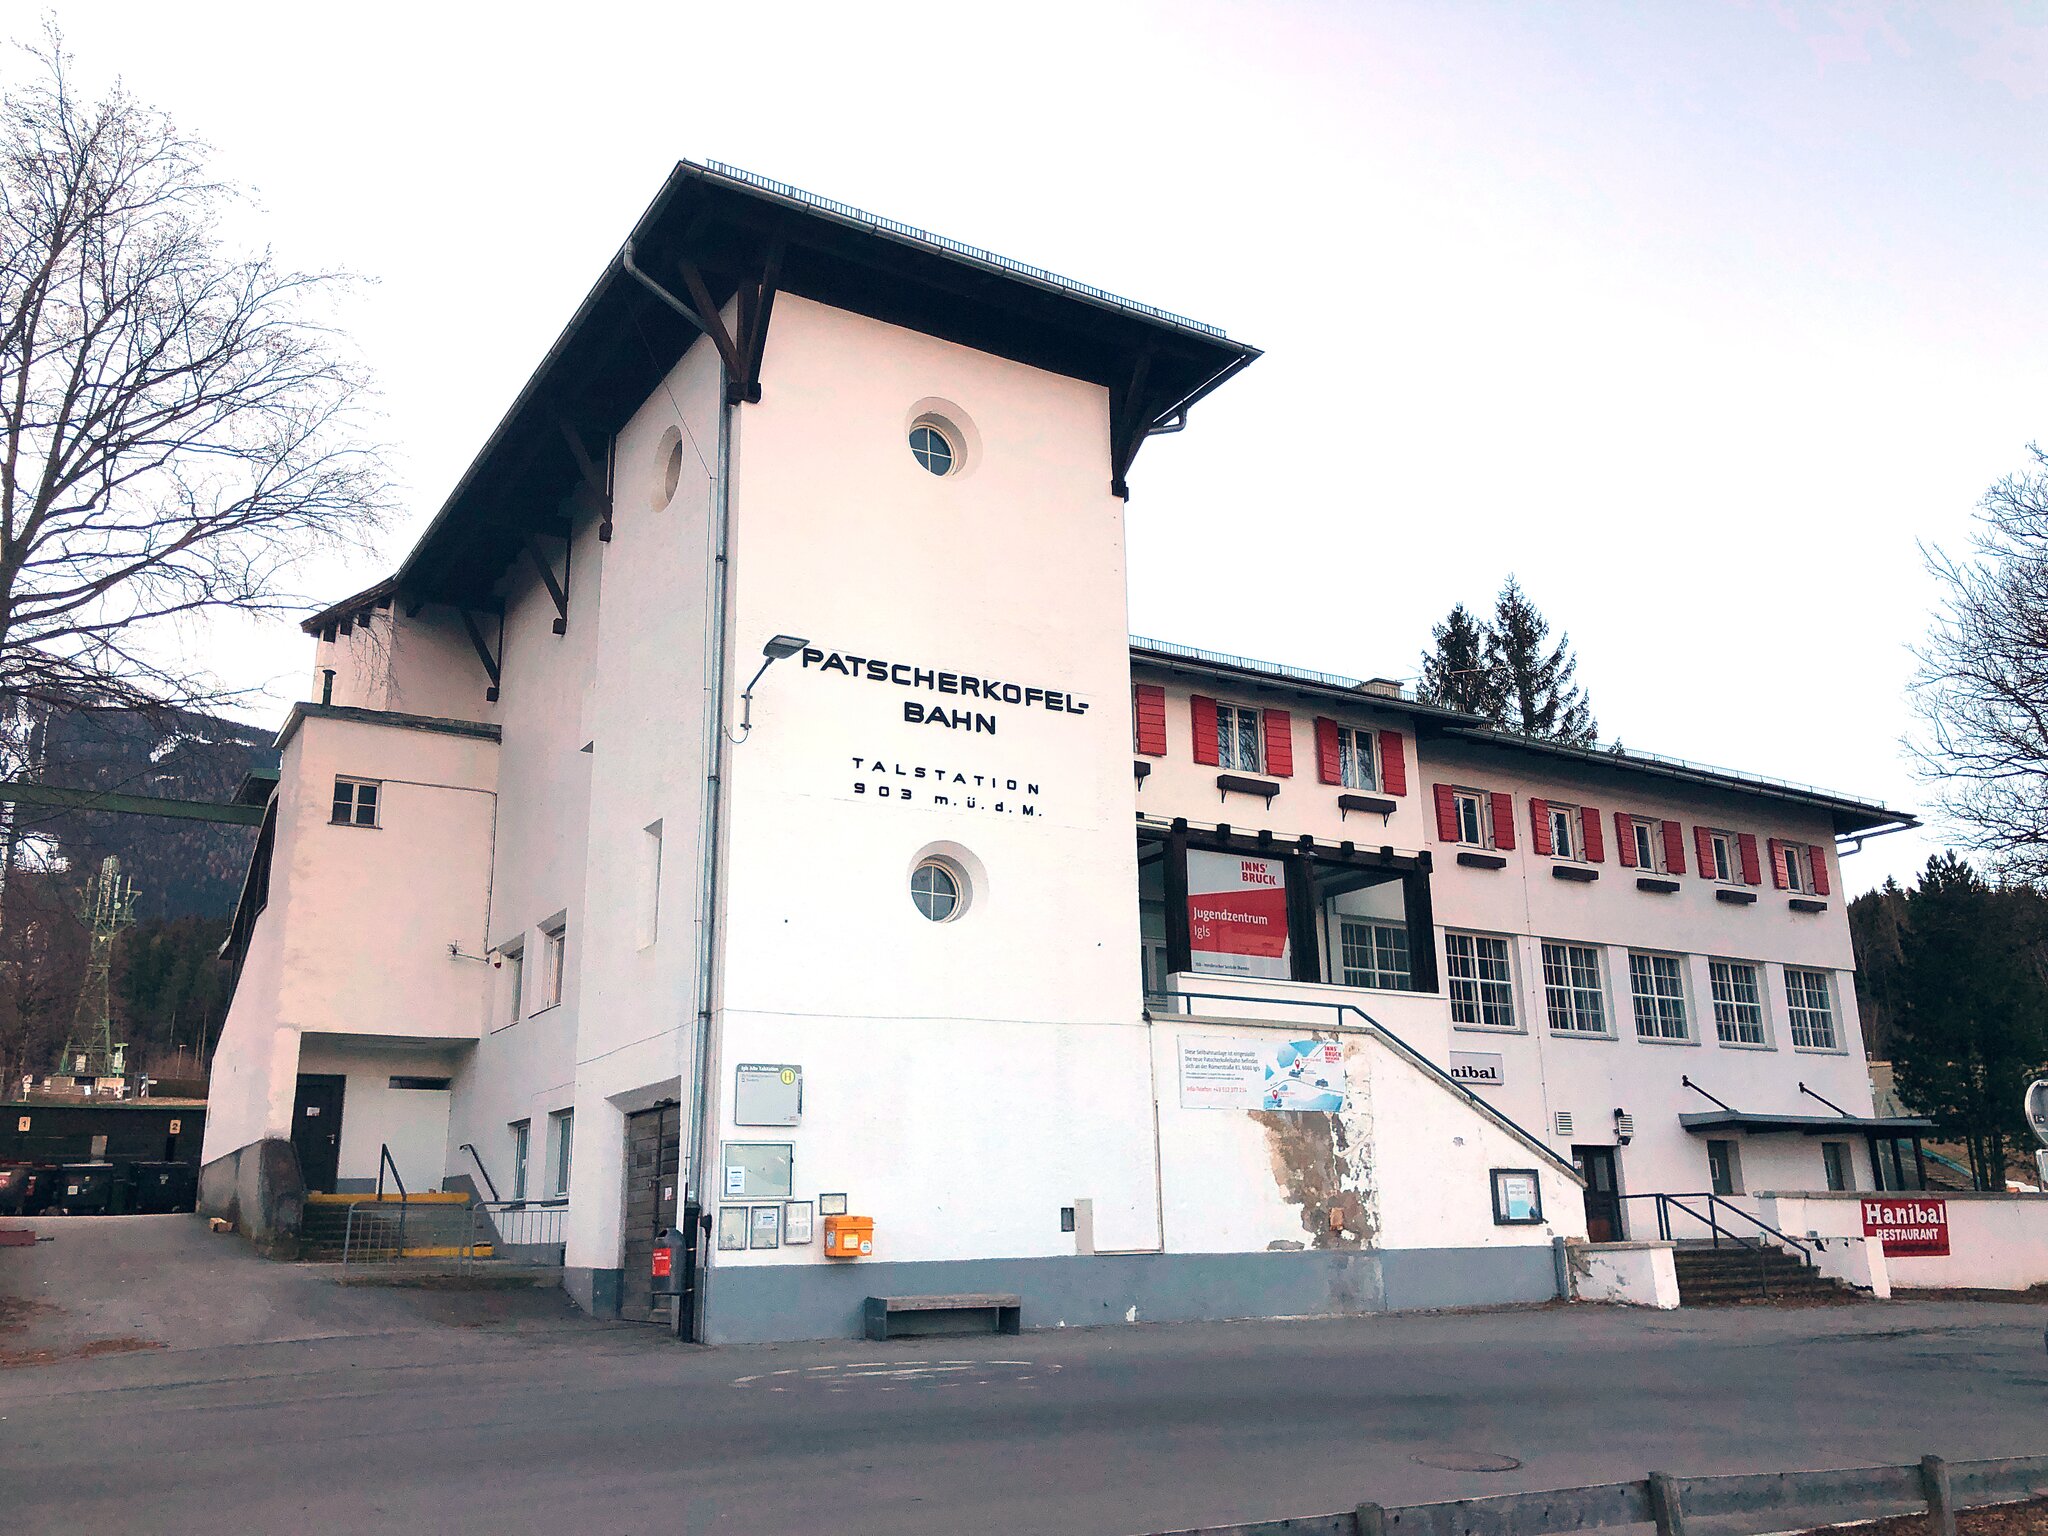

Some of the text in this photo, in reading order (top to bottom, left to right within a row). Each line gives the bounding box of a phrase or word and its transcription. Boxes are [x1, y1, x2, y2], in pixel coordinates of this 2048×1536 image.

[802, 648, 1089, 715] PATSCHERKOFEL-
[904, 702, 996, 735] BAHN
[852, 757, 1040, 795] TALSTATION
[854, 782, 912, 800] 903
[1242, 872, 1276, 885] BRUCK
[1193, 907, 1268, 925] Jugendzentrum
[1194, 925, 1211, 939] Igls
[785, 1072, 791, 1081] H
[21, 1120, 27, 1128] 1
[172, 1123, 178, 1131] 2
[1864, 1203, 1946, 1225] Hanibal
[1876, 1228, 1938, 1241] RESTAURANT
